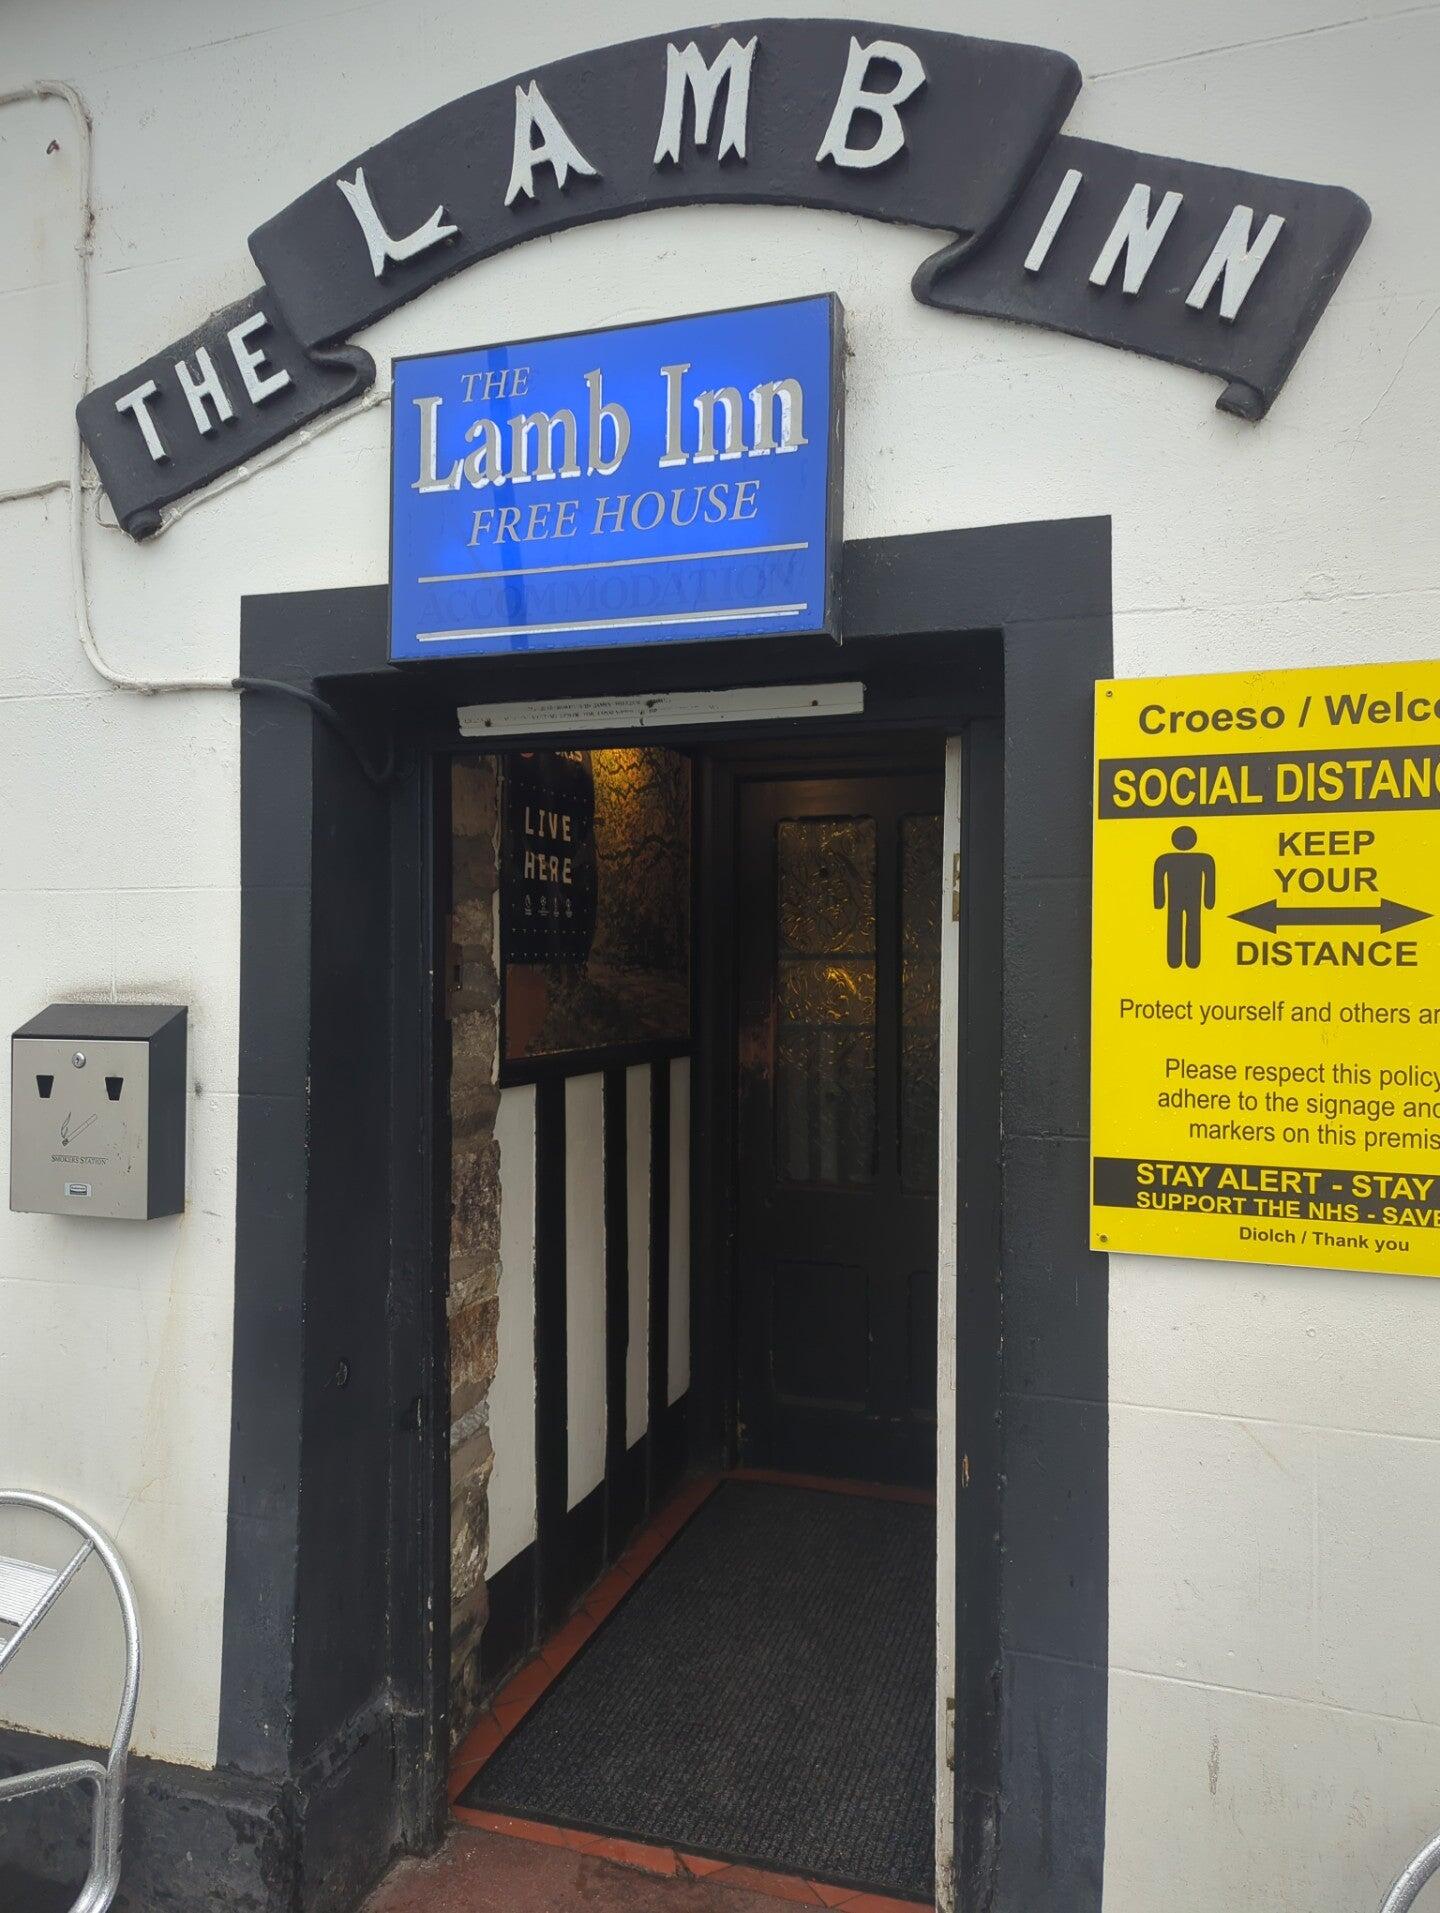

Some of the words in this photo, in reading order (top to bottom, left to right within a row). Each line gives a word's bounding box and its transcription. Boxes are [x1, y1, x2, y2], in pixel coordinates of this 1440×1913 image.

[117, 311, 293, 462] THE
[340, 36, 926, 277] LAMB
[1024, 168, 1285, 322] INN
[461, 367, 531, 403] THE
[411, 368, 631, 494] Lamb
[659, 363, 809, 468] Inn
[467, 501, 579, 547] FREE
[592, 480, 761, 535] HOUSE
[1138, 704, 1285, 734] Croeso
[1324, 692, 1440, 726] Welc
[1113, 766, 1263, 808] SOCIAL
[1276, 757, 1440, 803] DISTAN
[525, 806, 571, 842] LIVE
[1278, 830, 1375, 857] KEEP
[524, 852, 572, 885] HERE
[1274, 867, 1378, 893] YOUR
[1236, 941, 1417, 967] DISTANCE
[1120, 998, 1193, 1020] Protect
[1200, 1000, 1285, 1025] yourself
[1291, 1001, 1331, 1023] and
[1339, 1002, 1410, 1024] others
[1165, 1058, 1237, 1081] Please
[1245, 1062, 1325, 1087] respect
[1332, 1063, 1371, 1085] this
[1158, 1088, 1230, 1110] adhere
[1238, 1091, 1258, 1111] to
[1265, 1092, 1298, 1112] the
[1306, 1093, 1395, 1121] signage
[1189, 1120, 1275, 1142] markers
[1283, 1124, 1309, 1144] on
[1318, 1124, 1356, 1146] this
[1136, 1163, 1211, 1188] STAY
[1217, 1167, 1322, 1195] ALERT
[1351, 1175, 1434, 1202] STAY
[1136, 1191, 1247, 1215] SUPPORT
[1253, 1198, 1300, 1219] THE
[1308, 1202, 1359, 1223] NHS
[1239, 1227, 1296, 1244] Diolch
[1315, 1232, 1369, 1249] Thank
[1374, 1238, 1410, 1253] you
